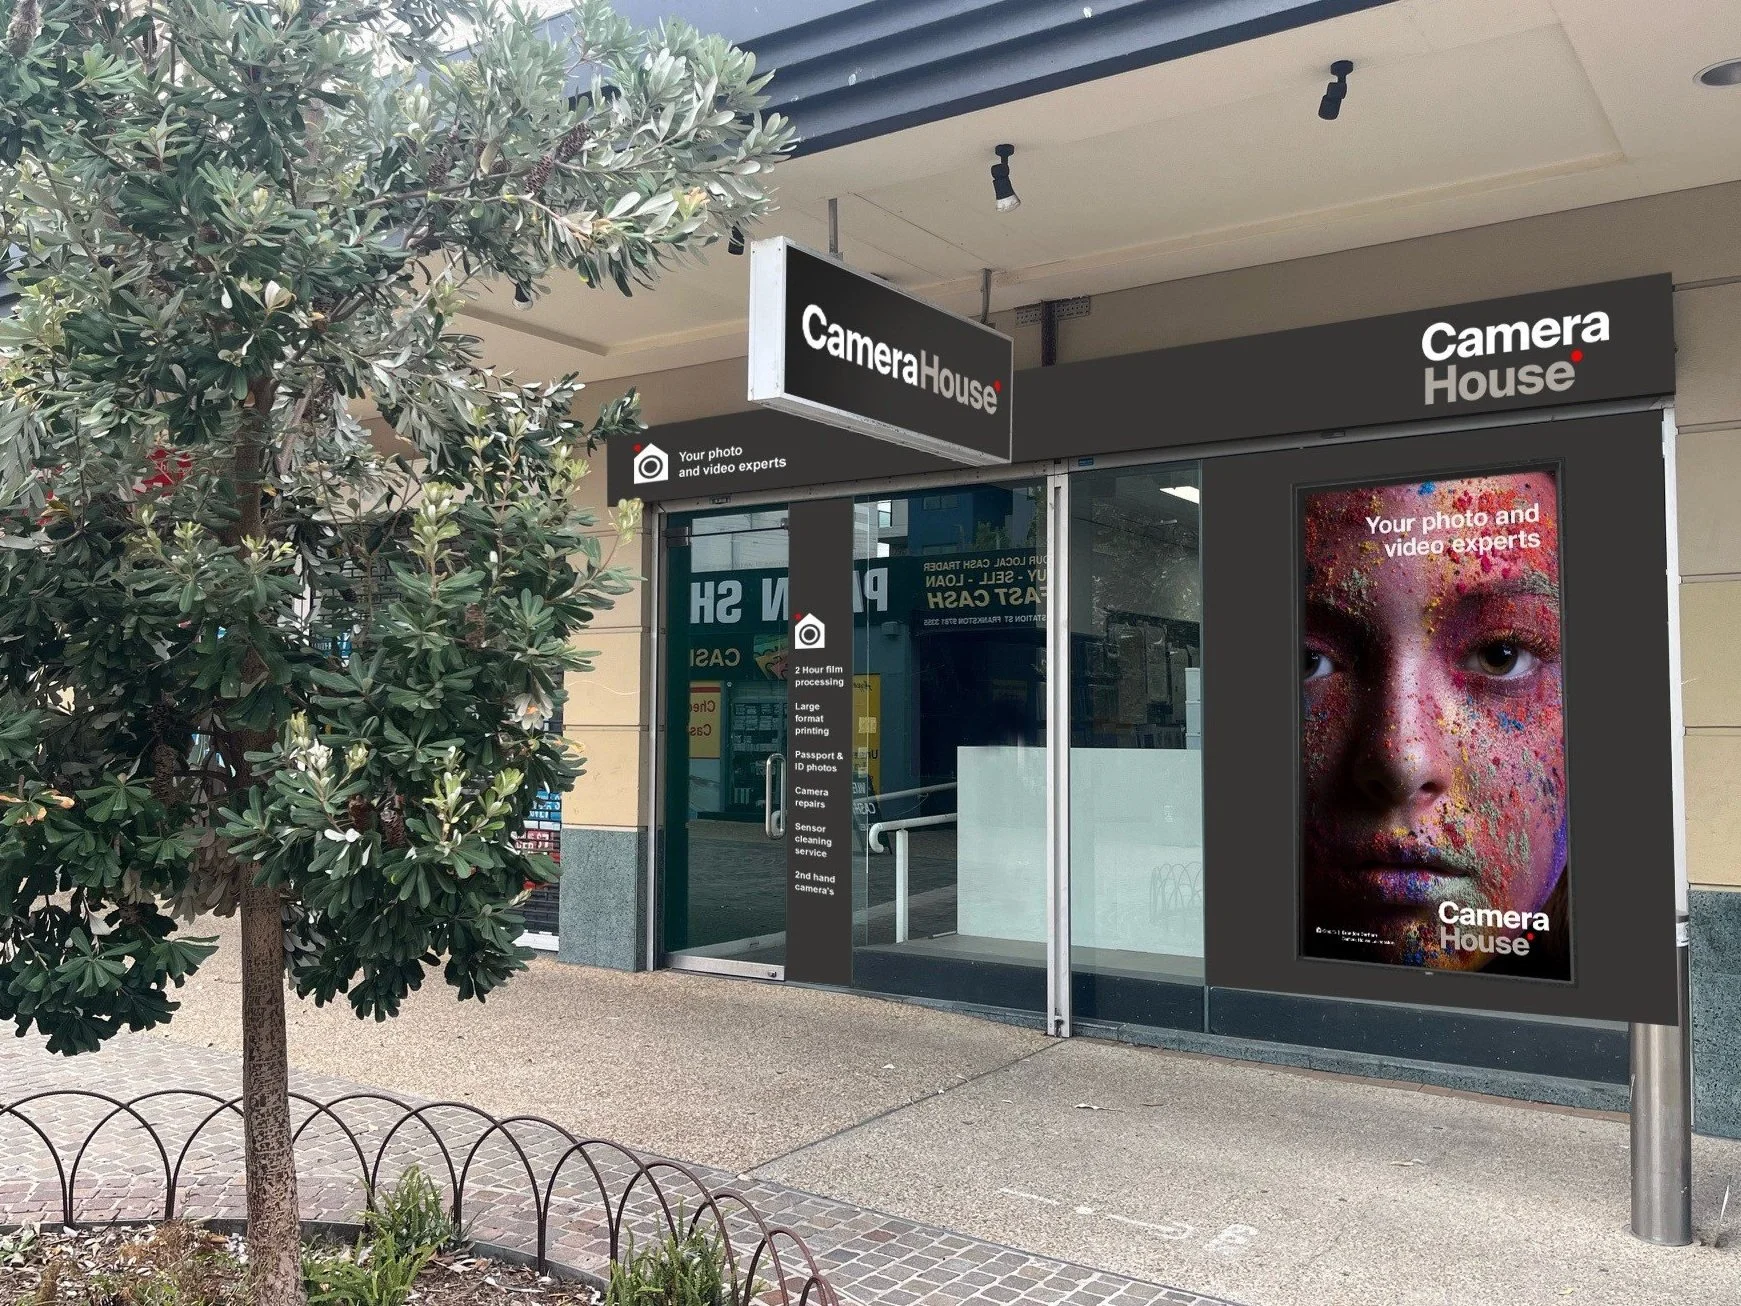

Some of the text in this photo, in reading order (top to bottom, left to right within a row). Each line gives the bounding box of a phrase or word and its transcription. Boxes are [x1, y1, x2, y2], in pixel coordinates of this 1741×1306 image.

[1421, 310, 1610, 362] Camera
[1424, 359, 1576, 406] House
[678, 445, 744, 464] Your photo
[678, 456, 787, 478] and video experts
[1365, 503, 1540, 536] Your photo and
[1384, 530, 1542, 558] video experts
[795, 665, 844, 675] 2 Hour film
[795, 677, 845, 688] processing
[795, 702, 820, 713] Large
[795, 713, 824, 723] format
[795, 726, 830, 737] printing
[795, 750, 835, 763] Passport
[836, 752, 844, 761] &
[795, 762, 838, 774] ID photos
[795, 786, 829, 797] Camera
[795, 798, 826, 810] repairs
[795, 822, 826, 833] Sensor
[795, 834, 833, 848] cleaning
[795, 847, 828, 858] service
[795, 870, 836, 884] 2nd hand
[795, 882, 835, 896] camera's
[1438, 900, 1550, 932] Camera
[1439, 925, 1533, 957] House
